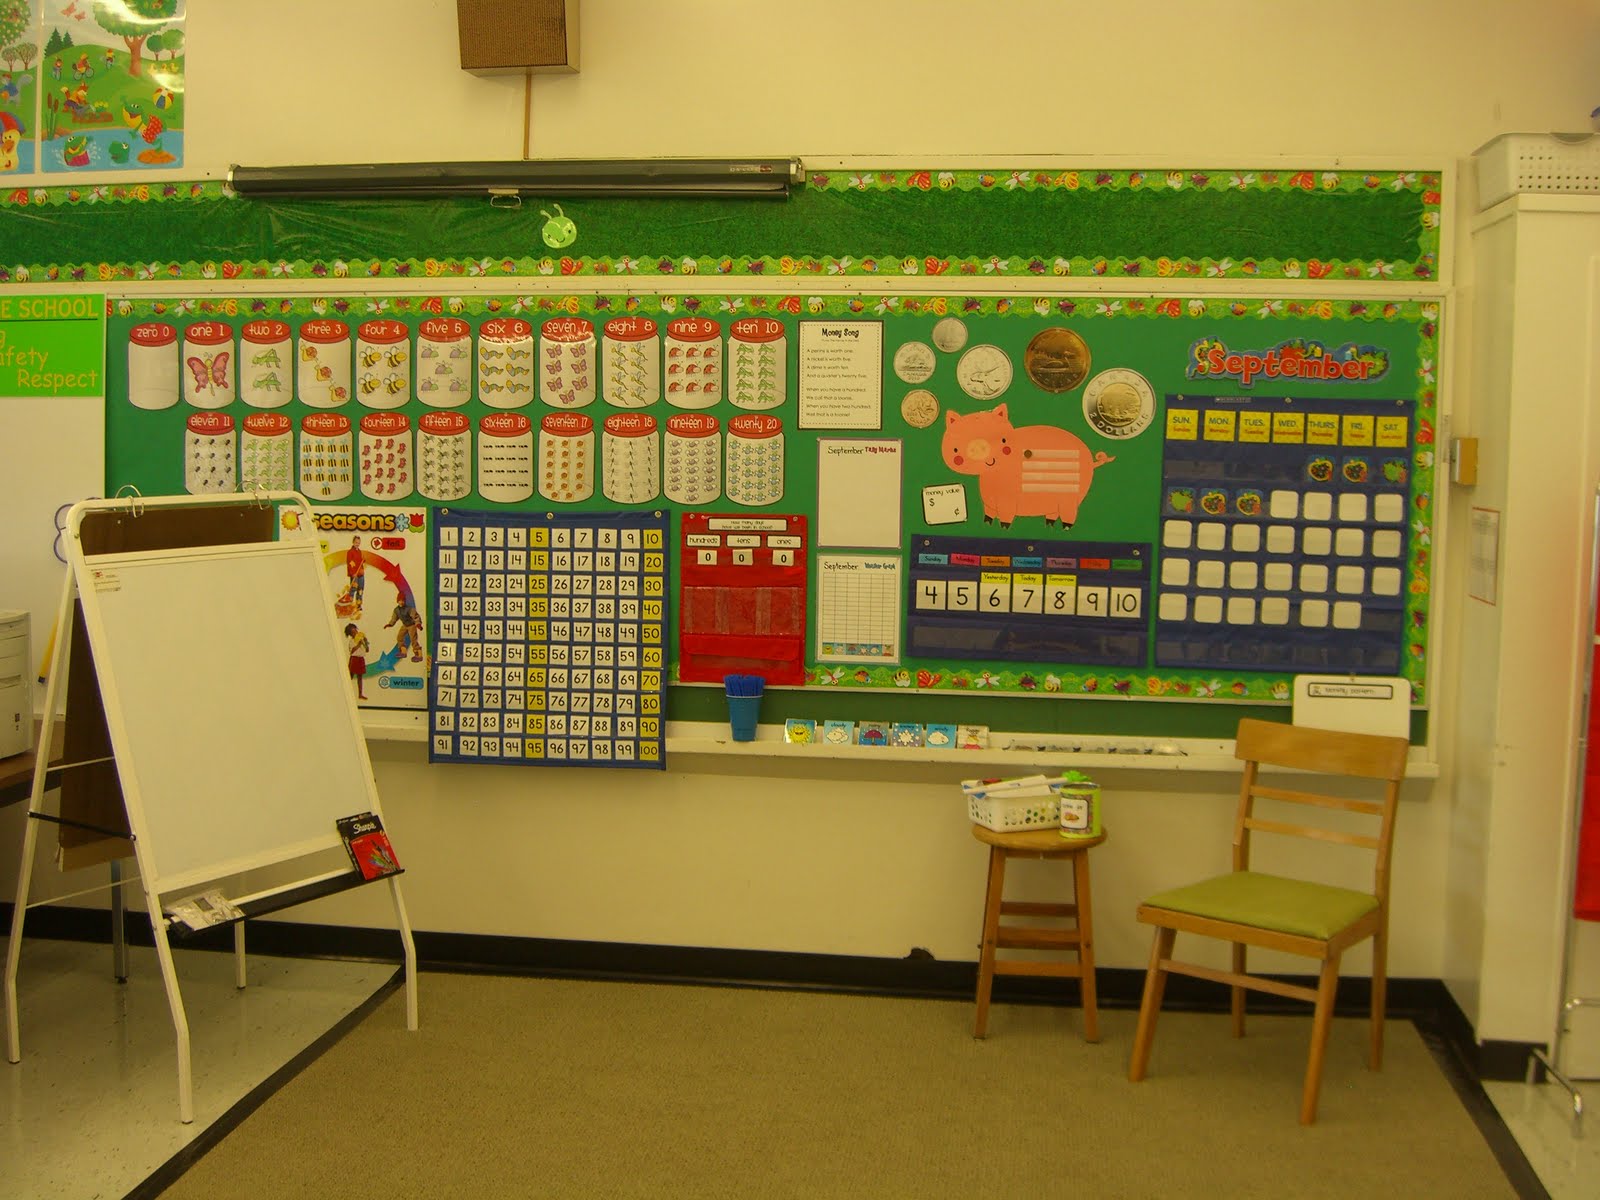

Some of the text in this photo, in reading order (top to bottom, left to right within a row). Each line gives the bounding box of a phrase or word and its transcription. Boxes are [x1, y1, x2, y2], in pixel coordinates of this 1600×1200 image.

[19, 299, 98, 318] SCHOOL
[137, 327, 169, 337] zero 0
[191, 325, 224, 336] one 1
[249, 325, 283, 335] two 2
[308, 324, 341, 336] three 3
[365, 325, 400, 335] four 4
[427, 323, 448, 333] five
[487, 323, 523, 334] six 6
[547, 322, 587, 333] seven 7
[609, 321, 652, 335] eight 8
[675, 322, 711, 332] nine 9
[737, 322, 778, 333] ten 10
[822, 328, 859, 338] Money Song
[1208, 350, 1374, 384] September
[18, 369, 97, 393] Respect
[191, 416, 230, 426] eleven 11
[248, 417, 288, 427] twelve 12
[306, 418, 347, 428] thirteen 13
[365, 418, 405, 428] fourteen 14
[425, 415, 450, 426] fifteen
[485, 418, 526, 428] sixteen 16
[545, 418, 587, 428] seventeen 17
[608, 418, 652, 430] eighteen 18
[670, 418, 714, 428] nineteen 19
[1097, 413, 1149, 436] DOLLARS
[1173, 416, 1190, 424] SUN.
[1209, 417, 1229, 425] MON.
[1244, 419, 1265, 427] TUES.
[734, 419, 777, 433] twenty 20
[828, 446, 864, 456] September
[929, 498, 935, 506] $
[954, 508, 959, 516] ¢
[705, 553, 711, 561] 0
[739, 554, 744, 562] 0
[781, 555, 787, 563] 0
[824, 562, 858, 571] September
[984, 574, 1008, 583] Yesterday
[1021, 575, 1036, 583] Today
[444, 577, 661, 591] 21 22 23 24 25 26 27 28 29 30
[926, 586, 1137, 612] 4 5 6 7 8 9 10
[442, 646, 660, 663] 51 52 53 54 55 56 57 58 59 60
[393, 678, 419, 687] winter
[438, 739, 657, 755] 91 92 93 94 95 96 97 98 99 100
